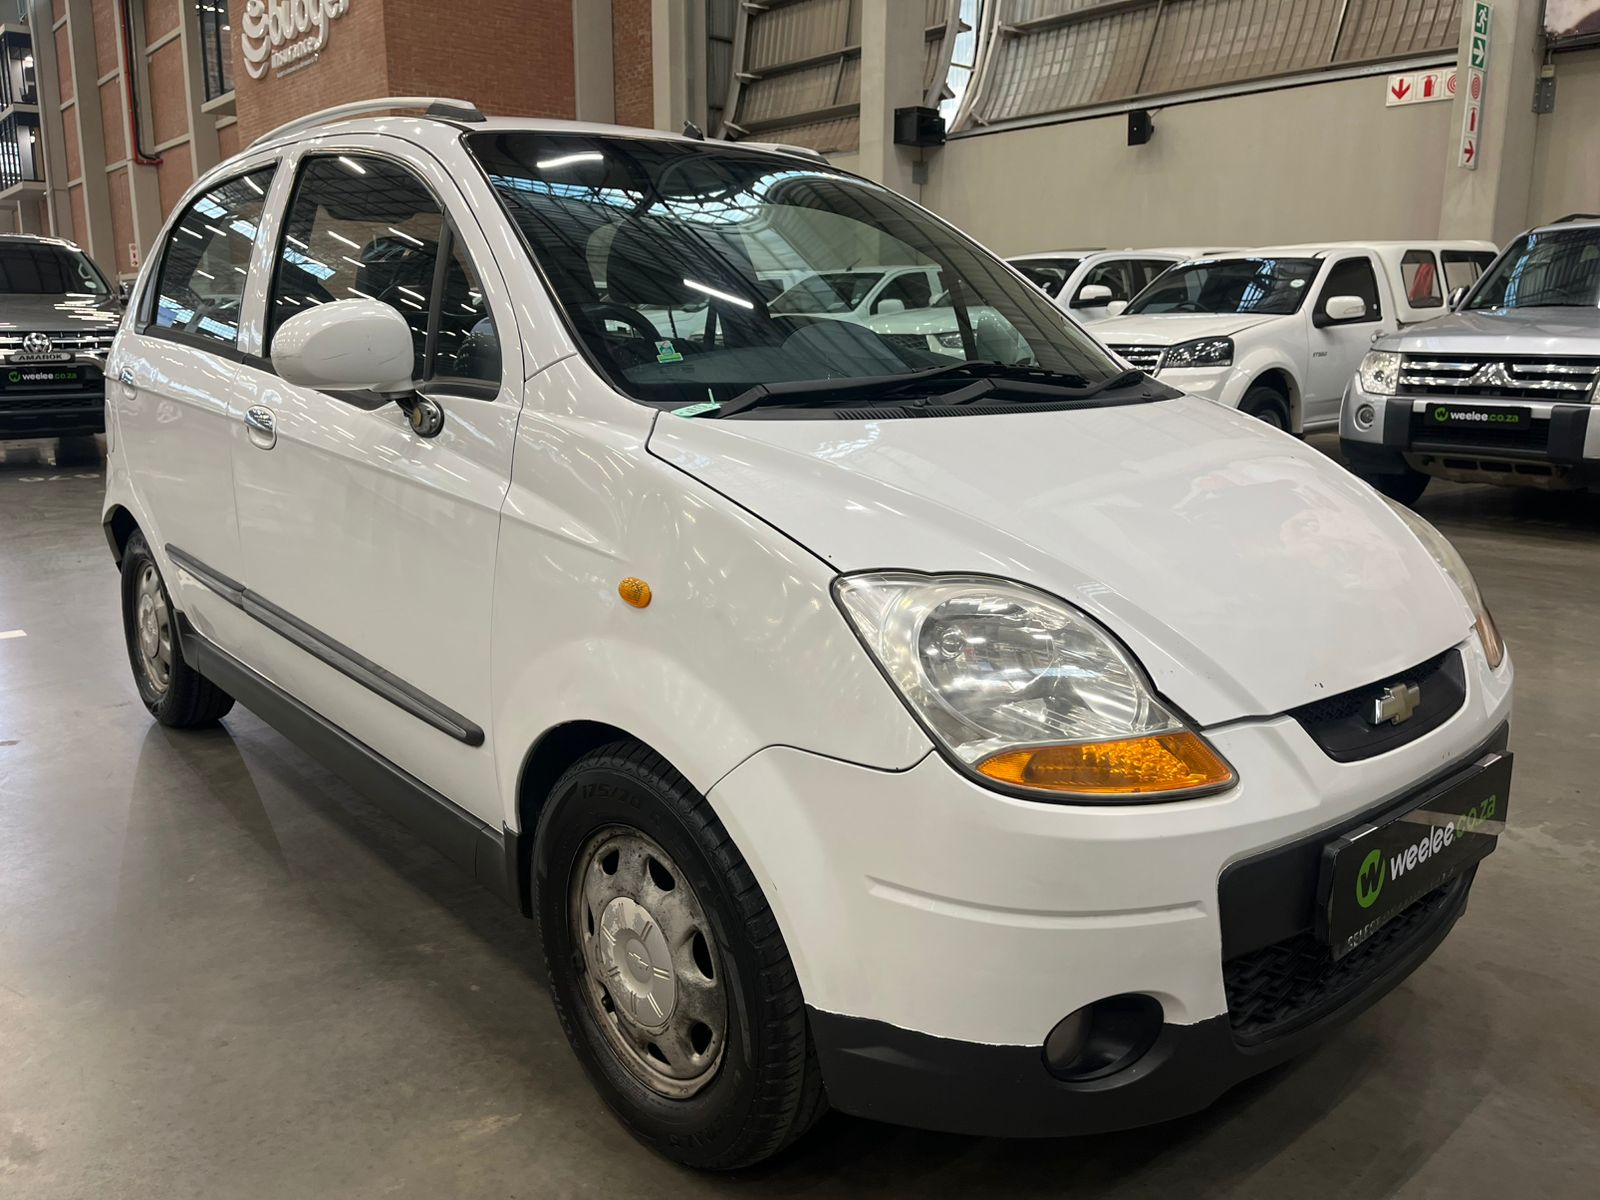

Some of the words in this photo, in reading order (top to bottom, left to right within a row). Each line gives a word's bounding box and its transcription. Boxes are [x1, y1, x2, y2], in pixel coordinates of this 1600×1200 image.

[18, 354, 63, 362] AMAROK
[1450, 411, 1520, 423] weelee.co.za
[1390, 795, 1497, 881] weelee.co.za
